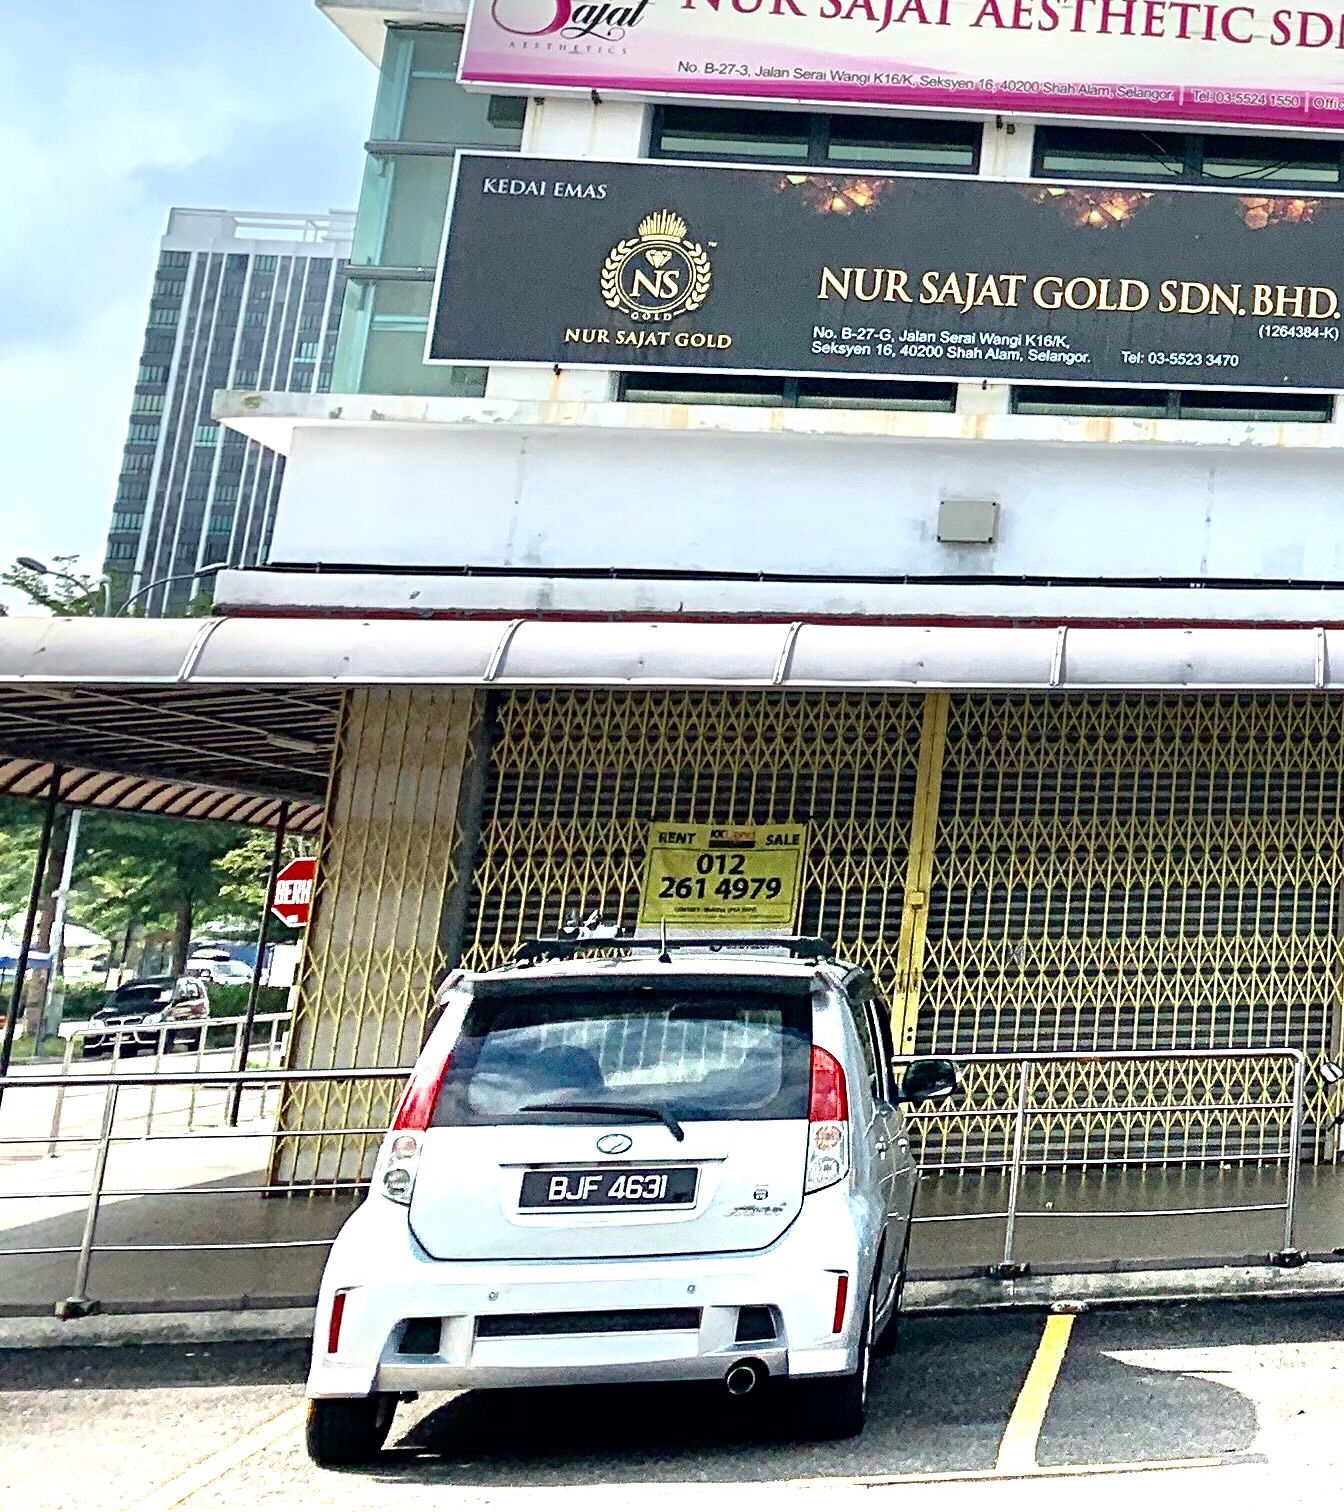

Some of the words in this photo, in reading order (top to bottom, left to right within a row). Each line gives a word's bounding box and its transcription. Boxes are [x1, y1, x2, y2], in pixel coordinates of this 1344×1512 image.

[509, 41, 627, 55] AESTHETICS
[678, 61, 700, 73] No.
[704, 62, 749, 78] B-27-3,
[755, 64, 790, 79] Jalan
[793, 66, 826, 81] Serai
[830, 69, 870, 86] Wangi
[919, 74, 976, 91] Seksyen
[1000, 79, 1040, 93] 40200
[1043, 81, 1075, 94] Shah
[1077, 83, 1113, 98] Alam,
[1215, 92, 1264, 106] 03-5524
[1269, 94, 1300, 108] 1550
[482, 178, 546, 196] KEDAI
[554, 182, 607, 200] EMAS
[629, 268, 680, 301] NS
[817, 266, 913, 304] NUR
[919, 271, 1026, 314] SAJAT
[1032, 277, 1149, 312] GOLD
[1158, 281, 1246, 316] SDN.
[1252, 286, 1341, 321] BHD.
[629, 310, 674, 322] GOLD
[564, 328, 611, 345] NUR
[615, 330, 671, 349] SAJAT
[675, 331, 732, 349] GOLD
[813, 326, 838, 340] No.
[898, 328, 936, 344] Jalan
[939, 330, 975, 345] Serai
[978, 332, 1021, 347] Wangi
[1258, 324, 1340, 341] (1264384-K)
[811, 342, 871, 357] Seksyen
[874, 344, 896, 358] 16,
[899, 345, 943, 359] 40200
[947, 346, 982, 360] Shah
[984, 347, 1024, 364] Alam,
[1027, 349, 1091, 366] Selangor.
[1121, 351, 1144, 364] Tel:
[1147, 352, 1203, 367] 03-5523
[1205, 353, 1239, 368] 3470
[658, 832, 696, 844] RENT
[765, 834, 800, 846] SALE
[696, 853, 746, 875] 012
[659, 876, 706, 899] 261
[714, 877, 782, 900] 4979
[548, 1175, 601, 1201] BJF
[608, 1173, 666, 1201] 4631
